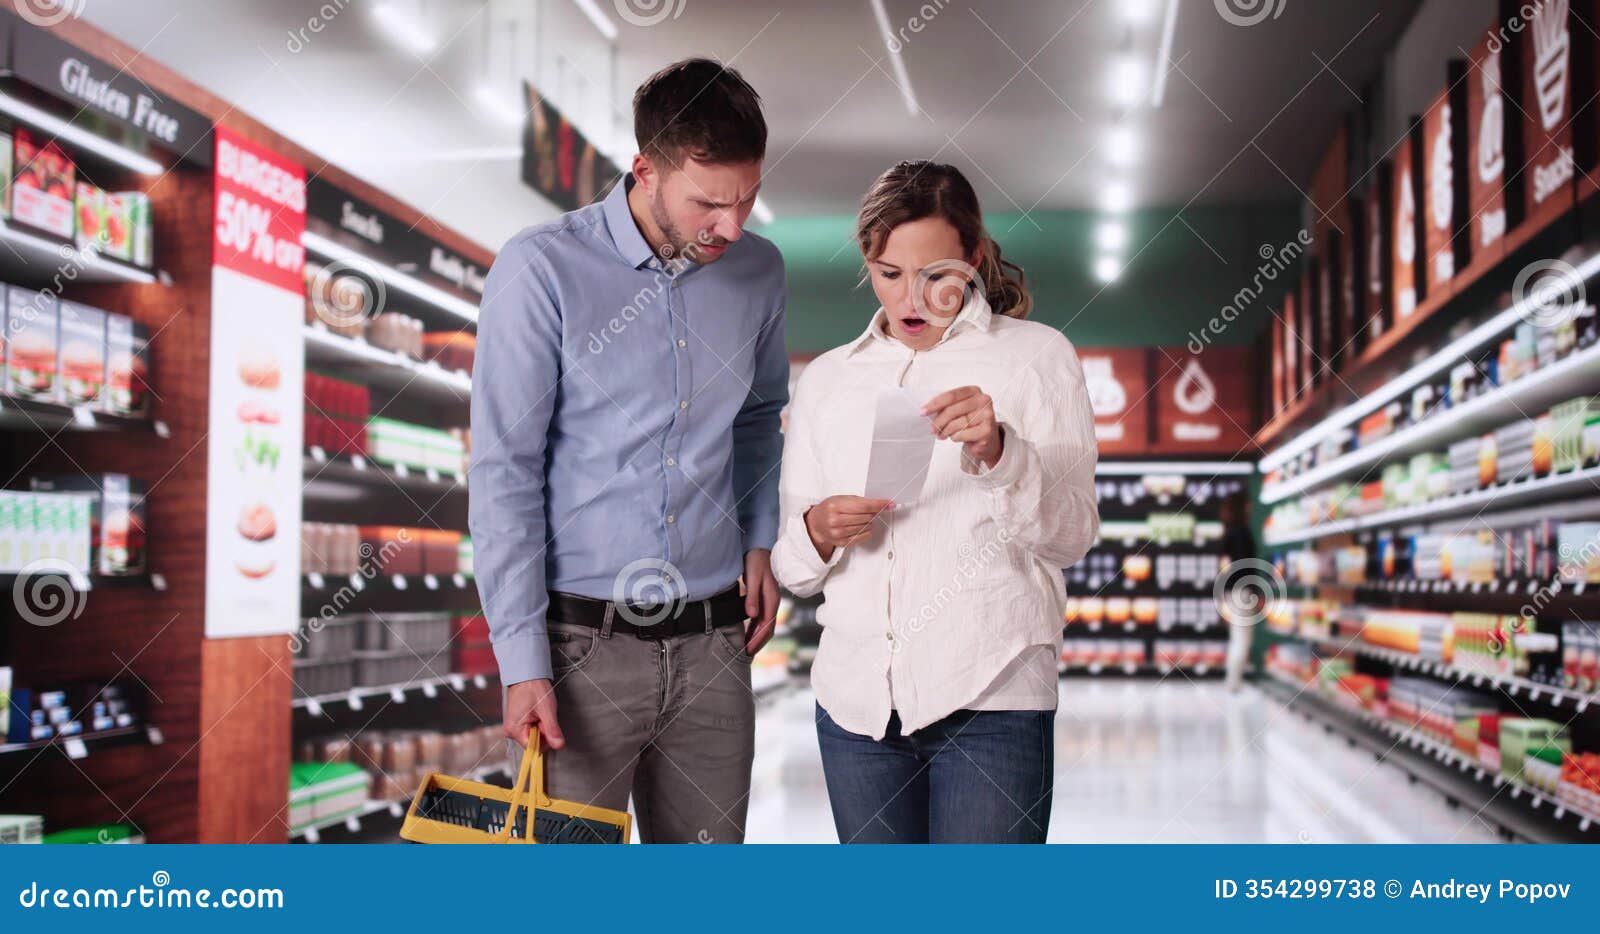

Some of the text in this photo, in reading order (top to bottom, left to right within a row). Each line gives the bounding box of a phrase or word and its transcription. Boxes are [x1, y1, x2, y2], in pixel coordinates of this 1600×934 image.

[60, 58, 179, 142] Gluten Free
[217, 138, 306, 214] BURGERS
[215, 190, 275, 264] 50%
